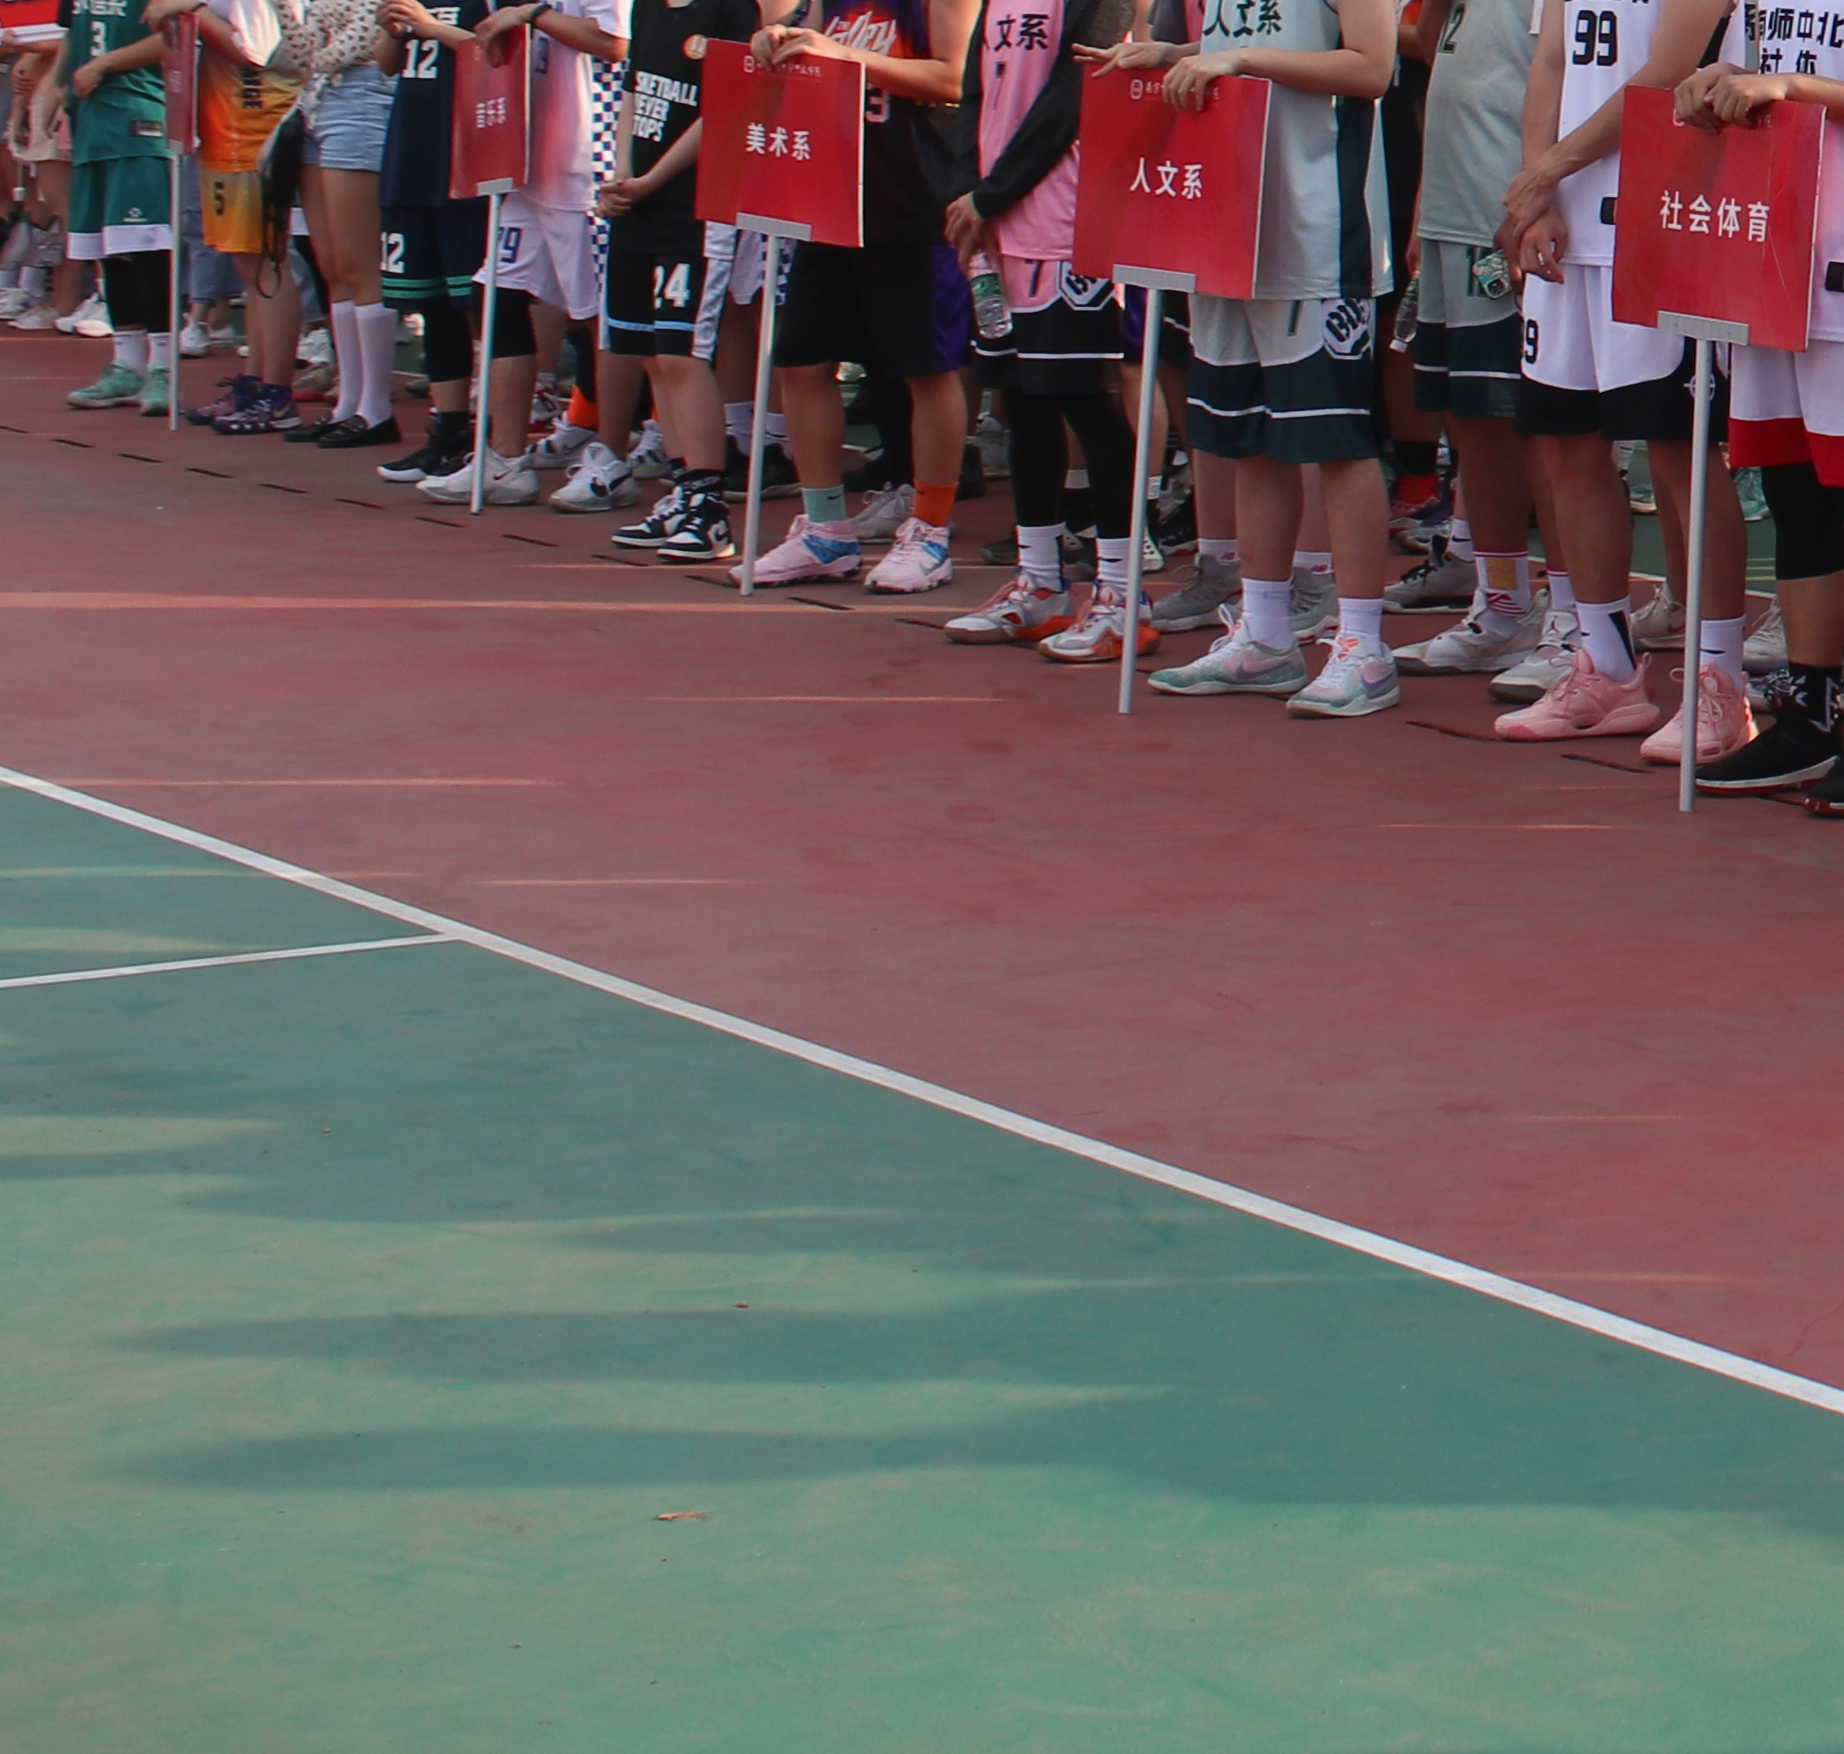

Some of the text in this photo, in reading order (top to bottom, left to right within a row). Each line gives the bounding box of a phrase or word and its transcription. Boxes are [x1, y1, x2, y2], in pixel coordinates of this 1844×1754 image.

[90, 20, 106, 57] 3
[985, 12, 1049, 51] 文系
[1572, 9, 1618, 67] 99
[402, 39, 439, 78] 12
[745, 123, 812, 162] 美术系
[1129, 156, 1204, 200] 人文系
[1659, 189, 1771, 244] 社会体育
